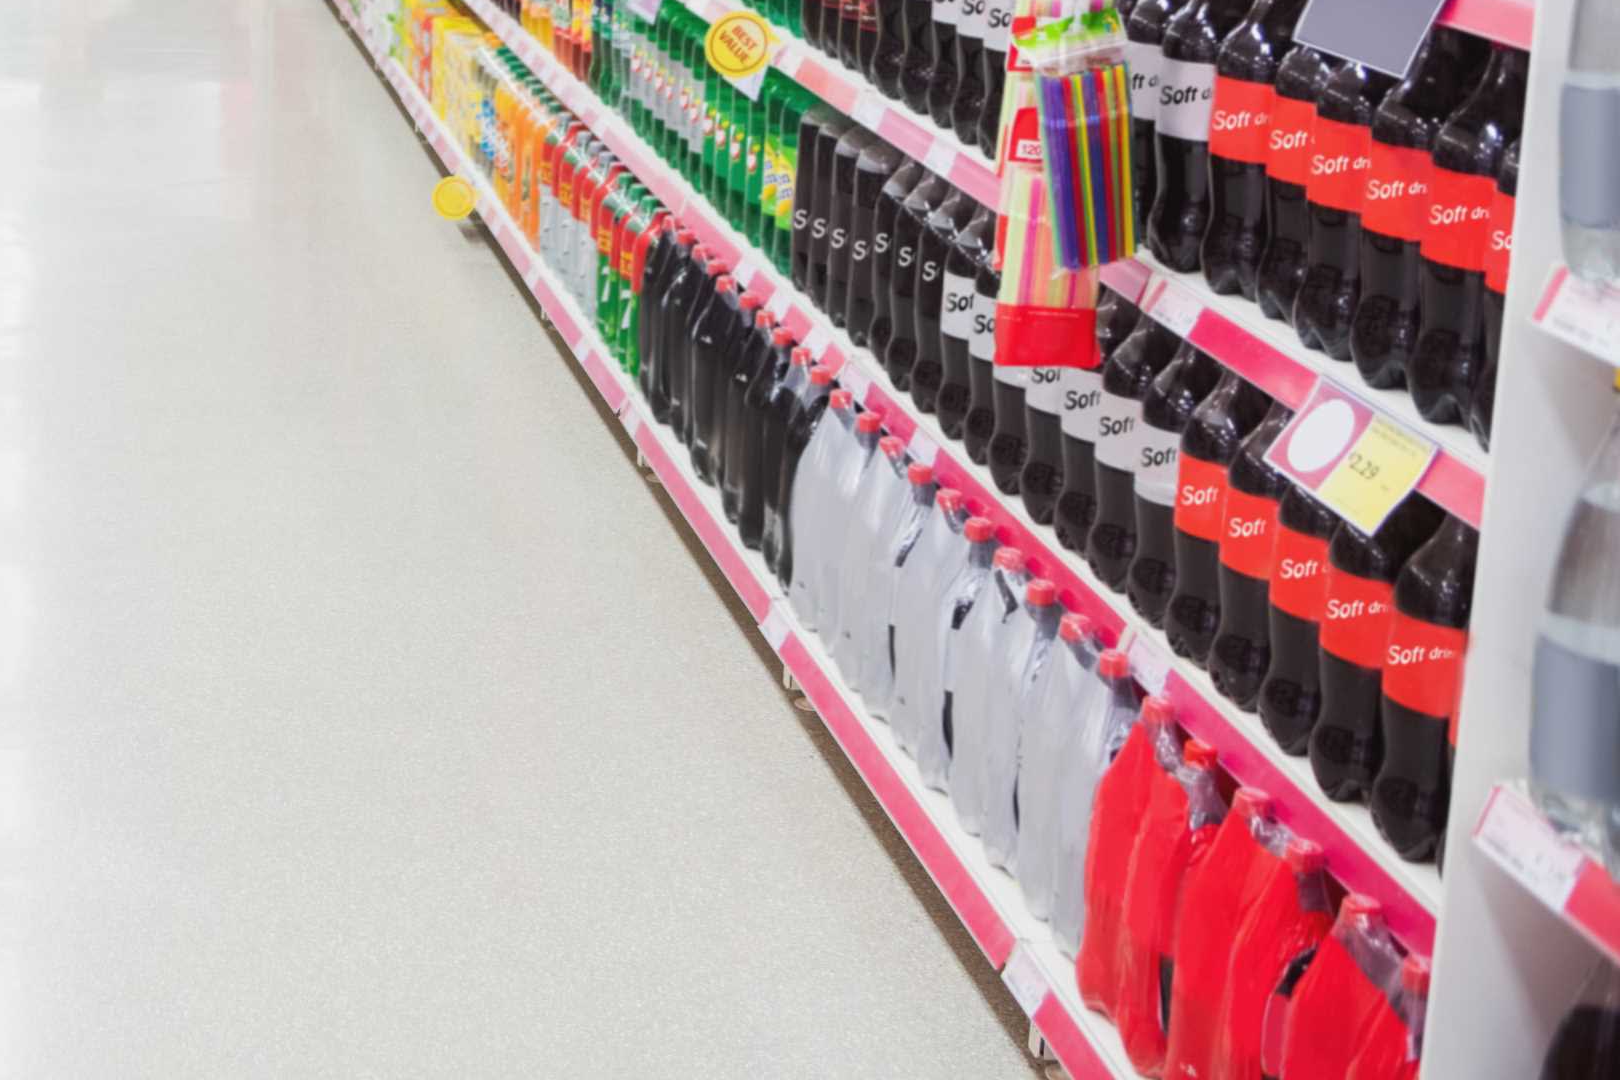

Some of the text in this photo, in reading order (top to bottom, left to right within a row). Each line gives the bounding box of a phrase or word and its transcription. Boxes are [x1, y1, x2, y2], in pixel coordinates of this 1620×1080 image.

[720, 30, 749, 64] VALUE
[732, 25, 757, 51] BEST
[1160, 84, 1200, 105] Soft
[1213, 110, 1250, 131] Soft
[1270, 130, 1307, 150] Soft
[1311, 155, 1348, 175] Soft
[1367, 179, 1404, 200] Soft
[1430, 204, 1467, 225] Soft
[1280, 559, 1318, 580] Soft
[1326, 599, 1364, 620] Soft
[1388, 645, 1425, 666] Soft
